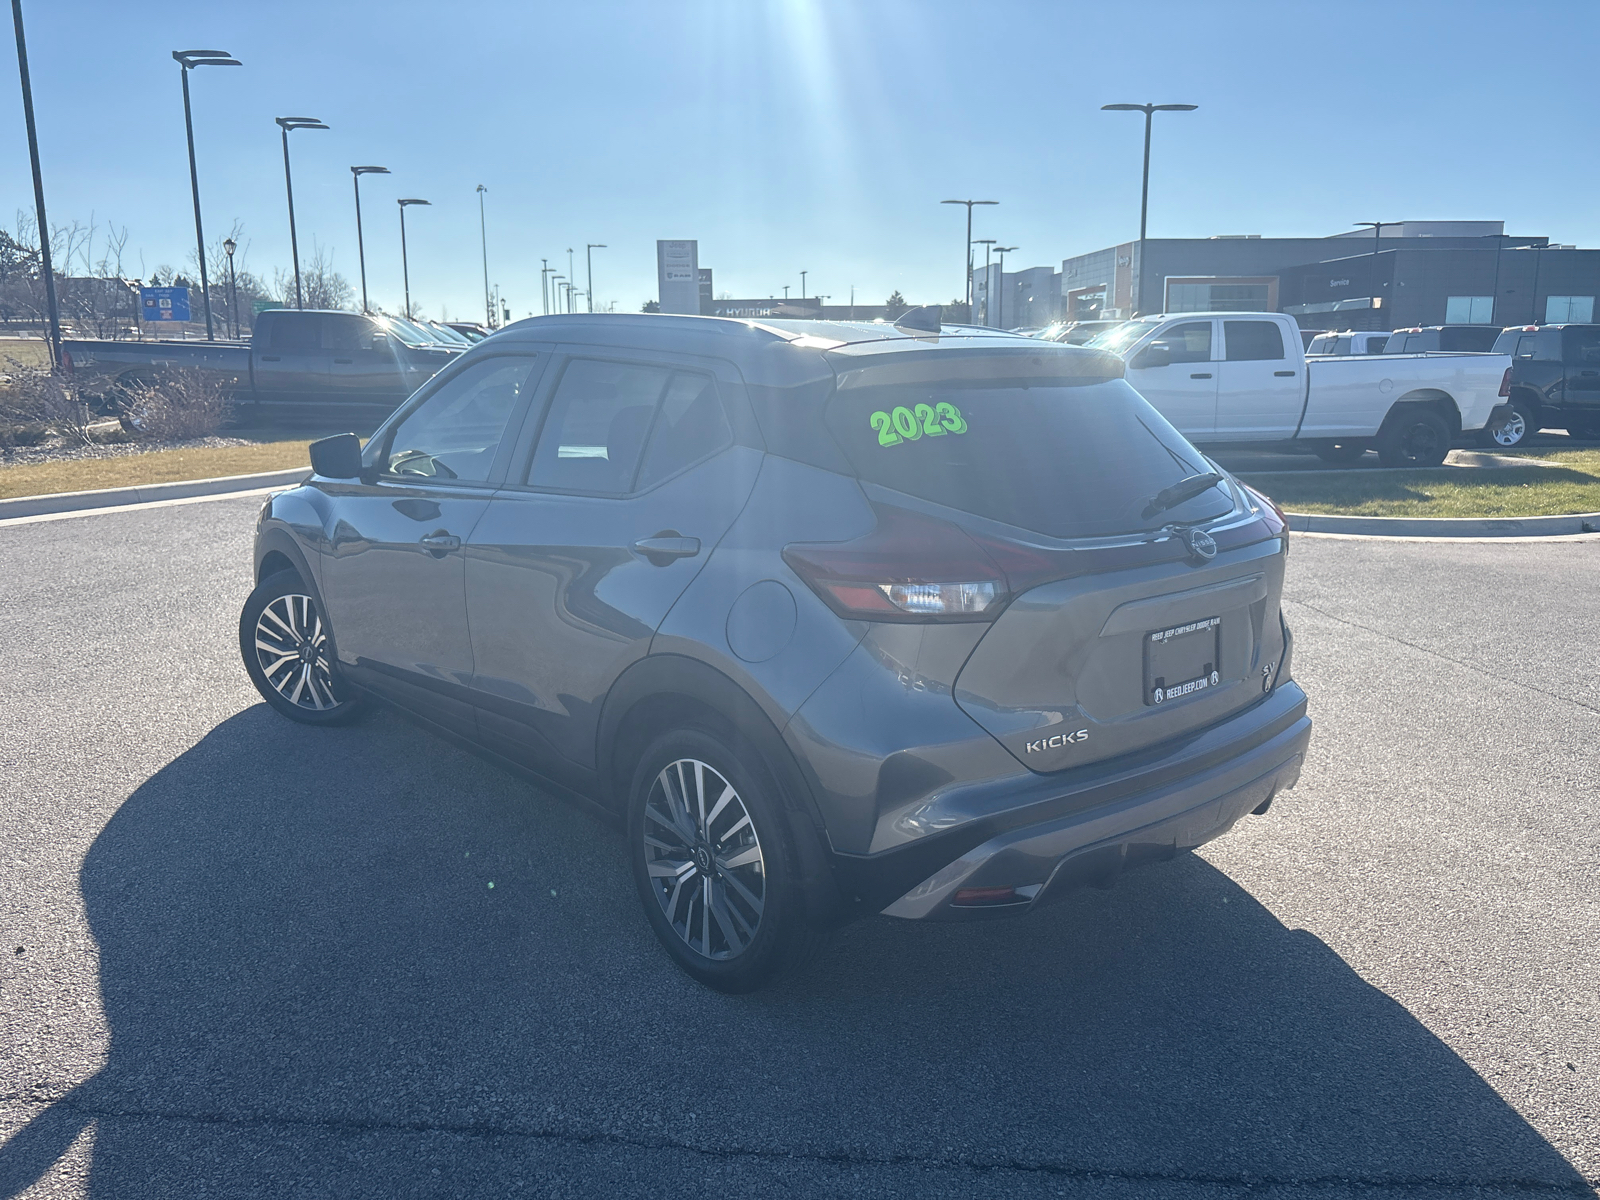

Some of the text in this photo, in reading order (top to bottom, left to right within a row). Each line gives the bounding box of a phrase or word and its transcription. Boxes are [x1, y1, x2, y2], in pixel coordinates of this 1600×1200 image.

[1329, 279, 1350, 288] Service
[870, 402, 968, 447] 2023
[1192, 538, 1216, 548] NISSAN
[1151, 617, 1221, 642] REED JEEP CHRYSLER DODGE RAM
[1261, 661, 1276, 677] SV
[1166, 677, 1208, 700] REEDJEEP.COM
[1025, 728, 1089, 754] KICKS
